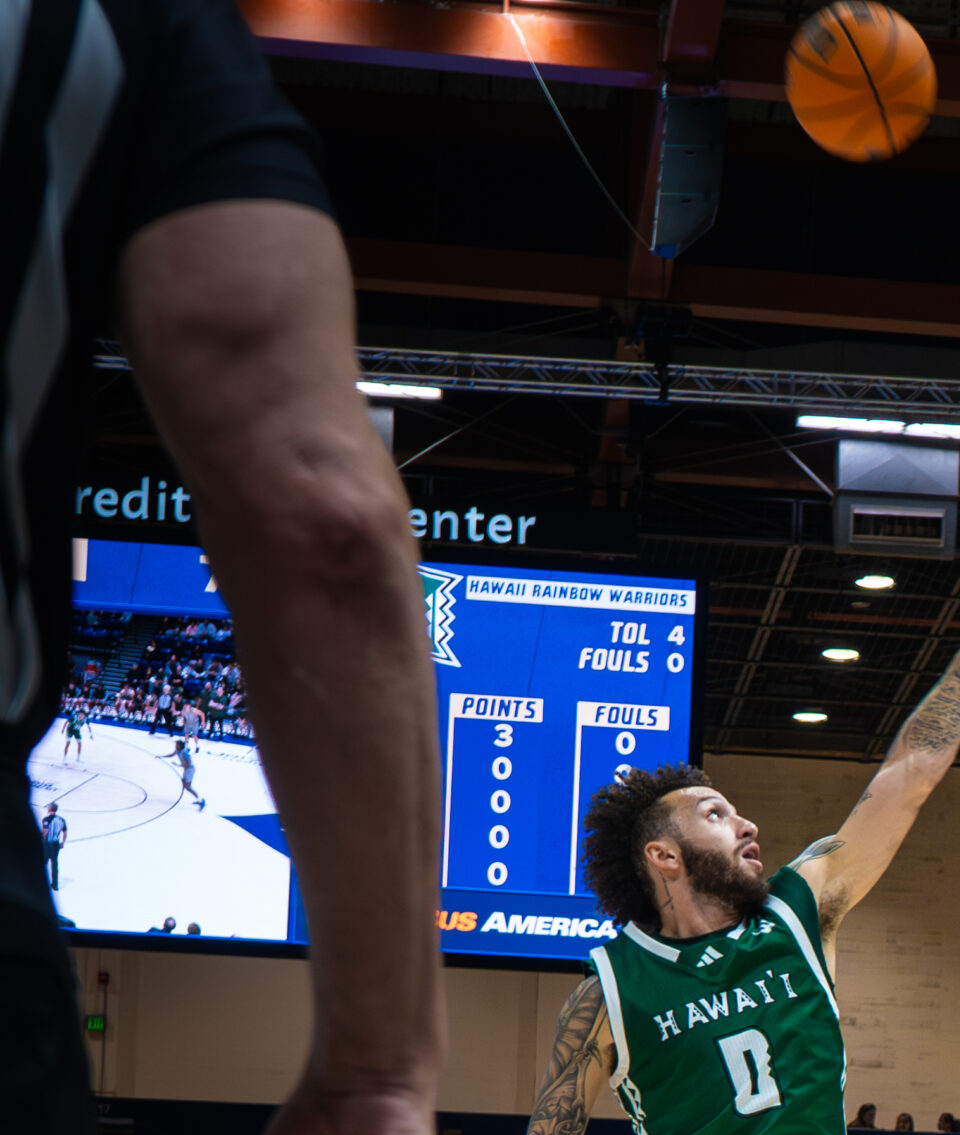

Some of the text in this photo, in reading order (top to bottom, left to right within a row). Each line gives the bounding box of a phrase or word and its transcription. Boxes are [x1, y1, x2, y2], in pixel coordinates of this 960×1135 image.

[75, 476, 536, 545] redit enter
[470, 580, 687, 607] HAWAII RAINBOW WARRIORS
[610, 621, 685, 646] TOL 4
[578, 647, 685, 673] FOULS 0
[462, 697, 536, 719] POINTS
[594, 705, 659, 727] FOULS
[493, 723, 514, 748] 3
[615, 731, 636, 755] 0
[491, 756, 513, 781] 0
[490, 789, 512, 814] 0
[488, 824, 510, 850] 0
[486, 861, 508, 886] 0
[435, 909, 478, 932] US
